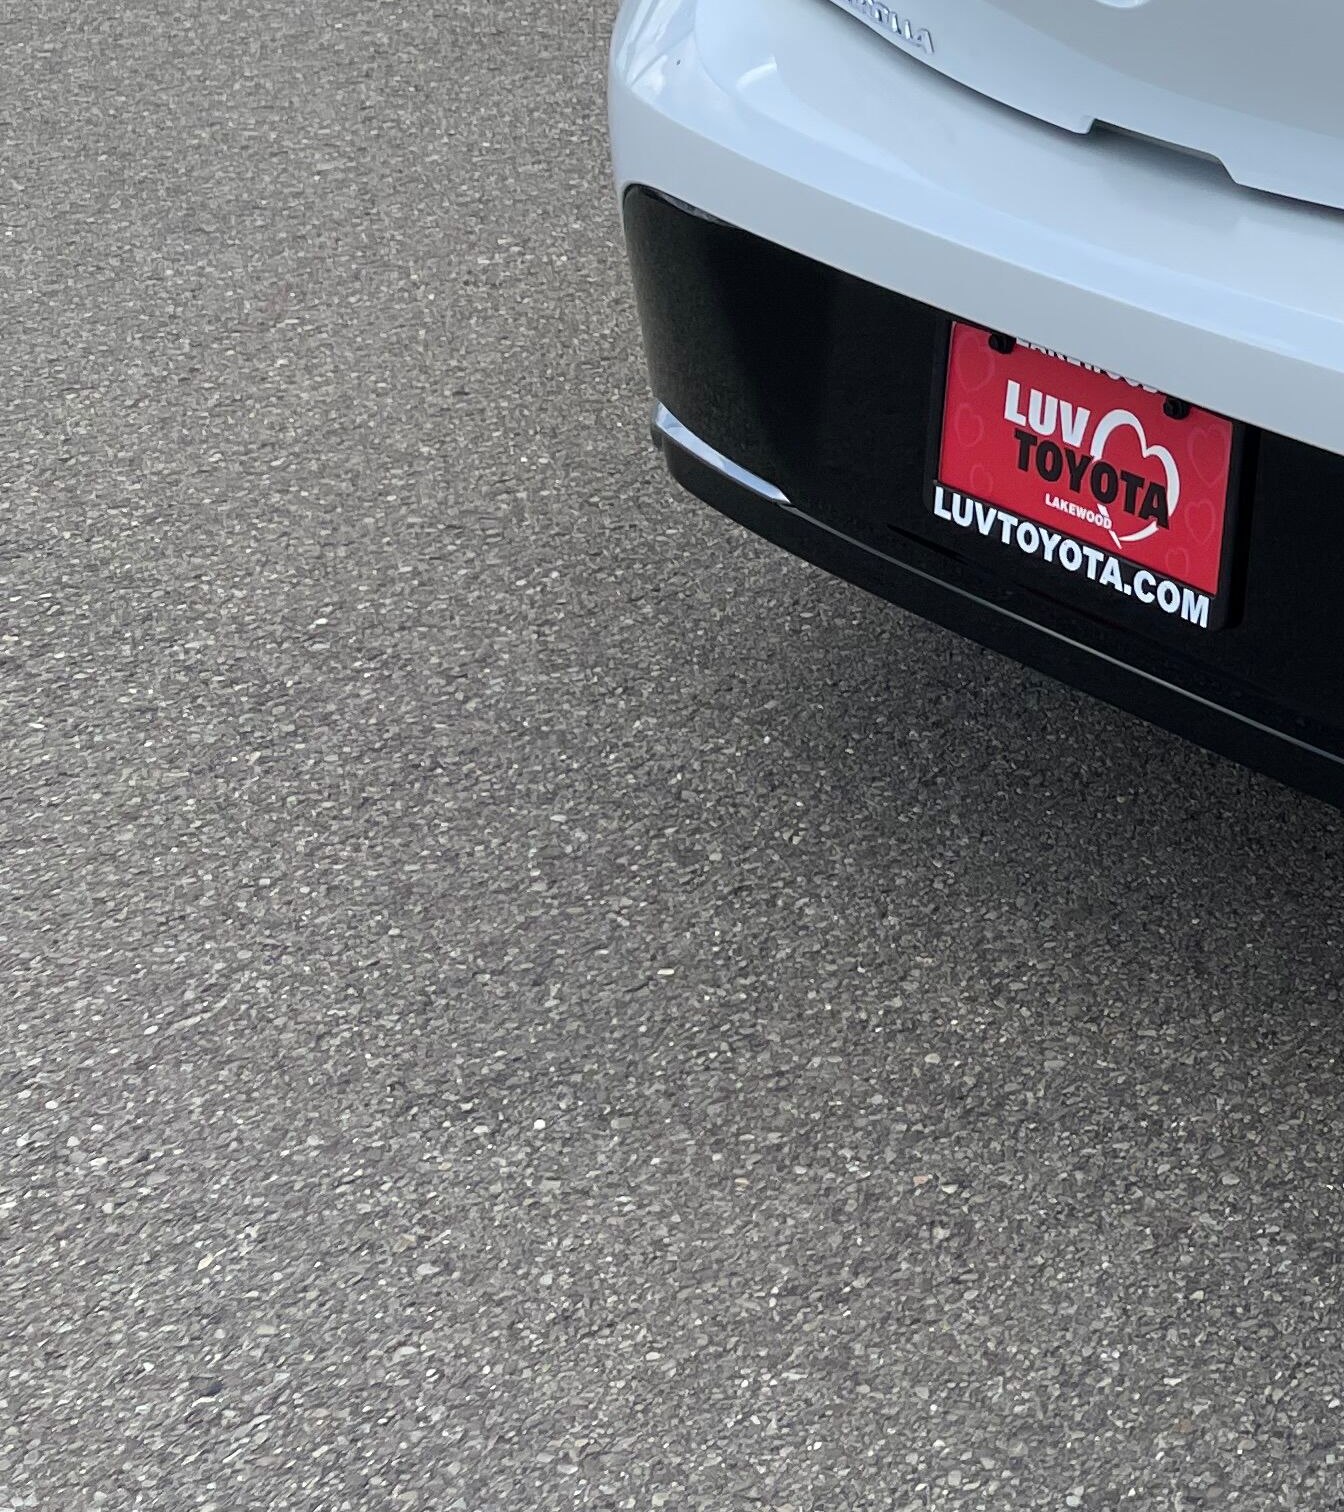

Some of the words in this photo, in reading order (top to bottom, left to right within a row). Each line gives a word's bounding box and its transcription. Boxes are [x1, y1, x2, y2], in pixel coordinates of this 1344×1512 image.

[1003, 379, 1091, 448] LUV
[1014, 428, 1170, 529] TOYOTA
[1045, 493, 1113, 530] LAKEWOOD
[933, 486, 1211, 628] LUVTOYOTA.COM
